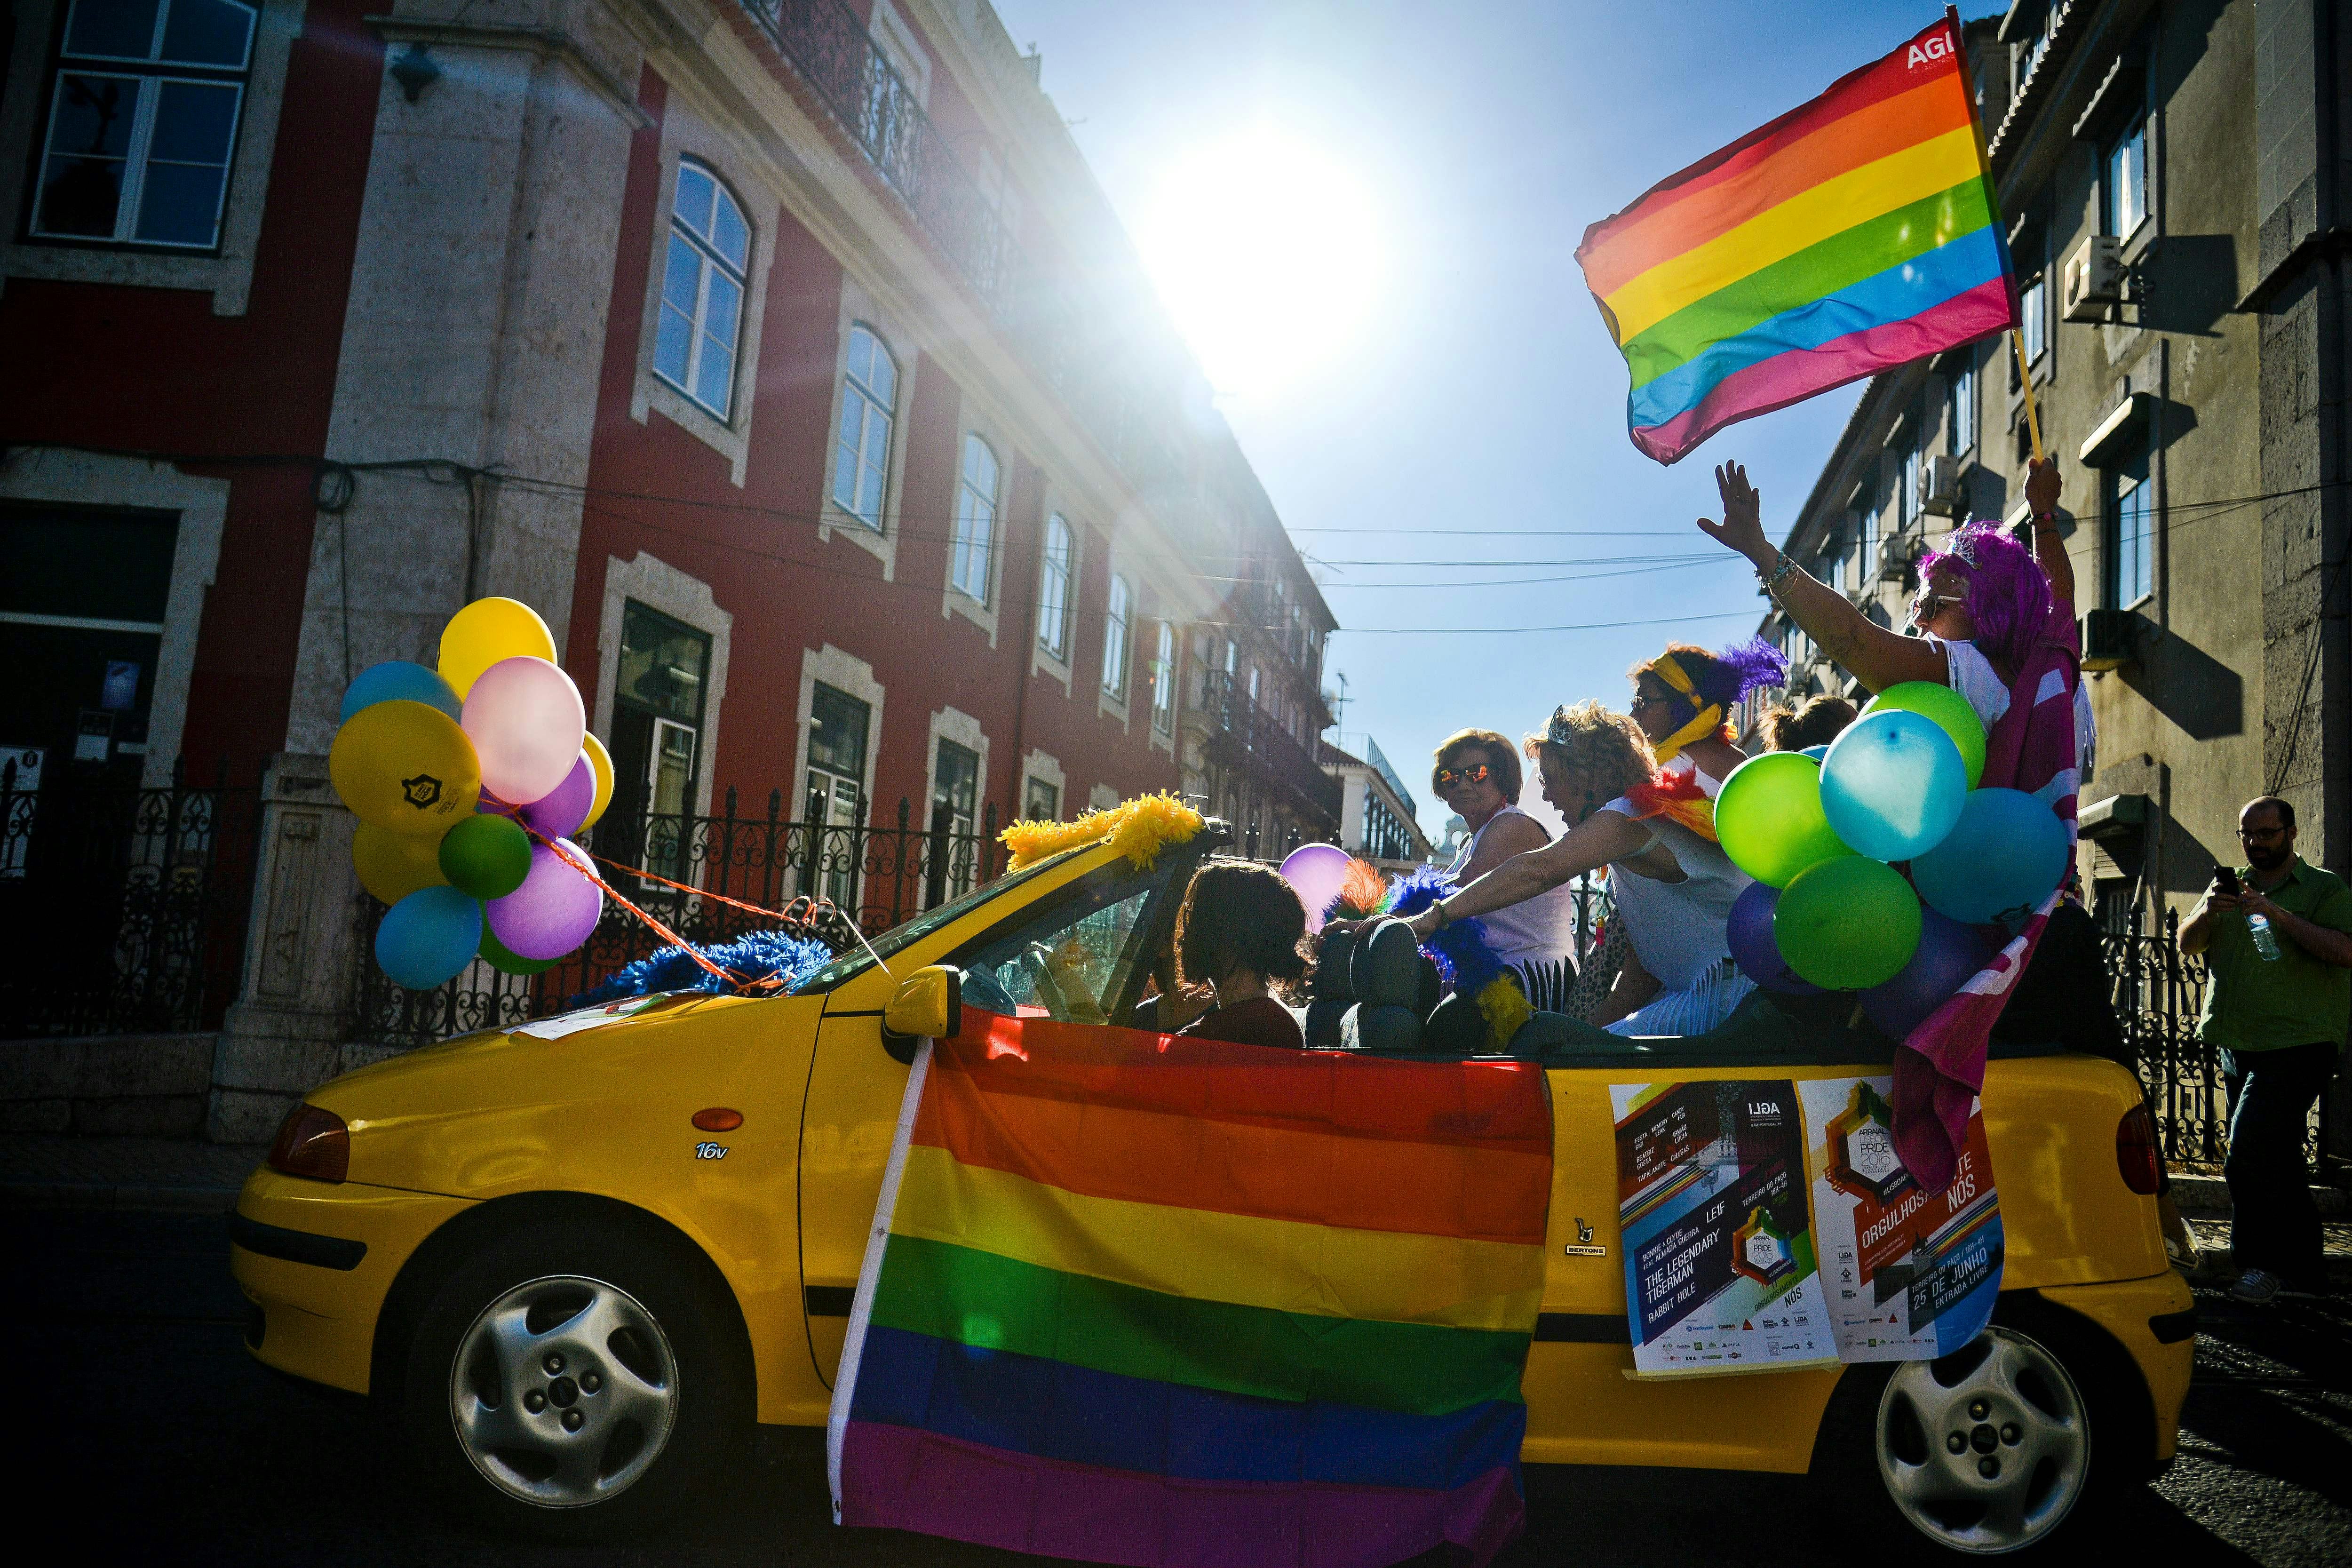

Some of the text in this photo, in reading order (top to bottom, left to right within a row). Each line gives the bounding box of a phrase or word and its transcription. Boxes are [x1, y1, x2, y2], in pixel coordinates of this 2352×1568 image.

[1672, 1106, 1684, 1118] CANDY
[1651, 1117, 1668, 1132] MEMORY
[1655, 1127, 1665, 1137] LEAK
[1635, 1131, 1647, 1144] FESTA
[1860, 1142, 1889, 1153] PRIDE
[696, 1142, 730, 1159] 16v
[1637, 1146, 1654, 1163] BEATRIZ
[1860, 1153, 1891, 1166] 2016
[1637, 1157, 1652, 1170] COSTA
[1742, 1186, 1765, 1207] TERREIRO
[1767, 1181, 1774, 1191] DO
[1947, 1174, 1975, 1213] NÓS
[1643, 1243, 1661, 1262] BONNIE
[1667, 1228, 1683, 1244] CLYDE
[1655, 1243, 1677, 1262] ALMADA
[1678, 1226, 1699, 1246] GUERRA
[1645, 1228, 1719, 1289] THE LEGENDARY
[1646, 1262, 1693, 1304] TIGERMAN
[1912, 1272, 1937, 1293] TERREIRO
[1939, 1265, 1946, 1274] DO
[1947, 1253, 1960, 1268] PAÇO
[1914, 1247, 1986, 1310] 25 DE JUNHO
[1784, 1287, 1802, 1308] NÓS
[1936, 1266, 1988, 1309] ENTRADA LIVRE
[1648, 1297, 1674, 1324] RABBIT
[1677, 1282, 1695, 1304] HOLE
